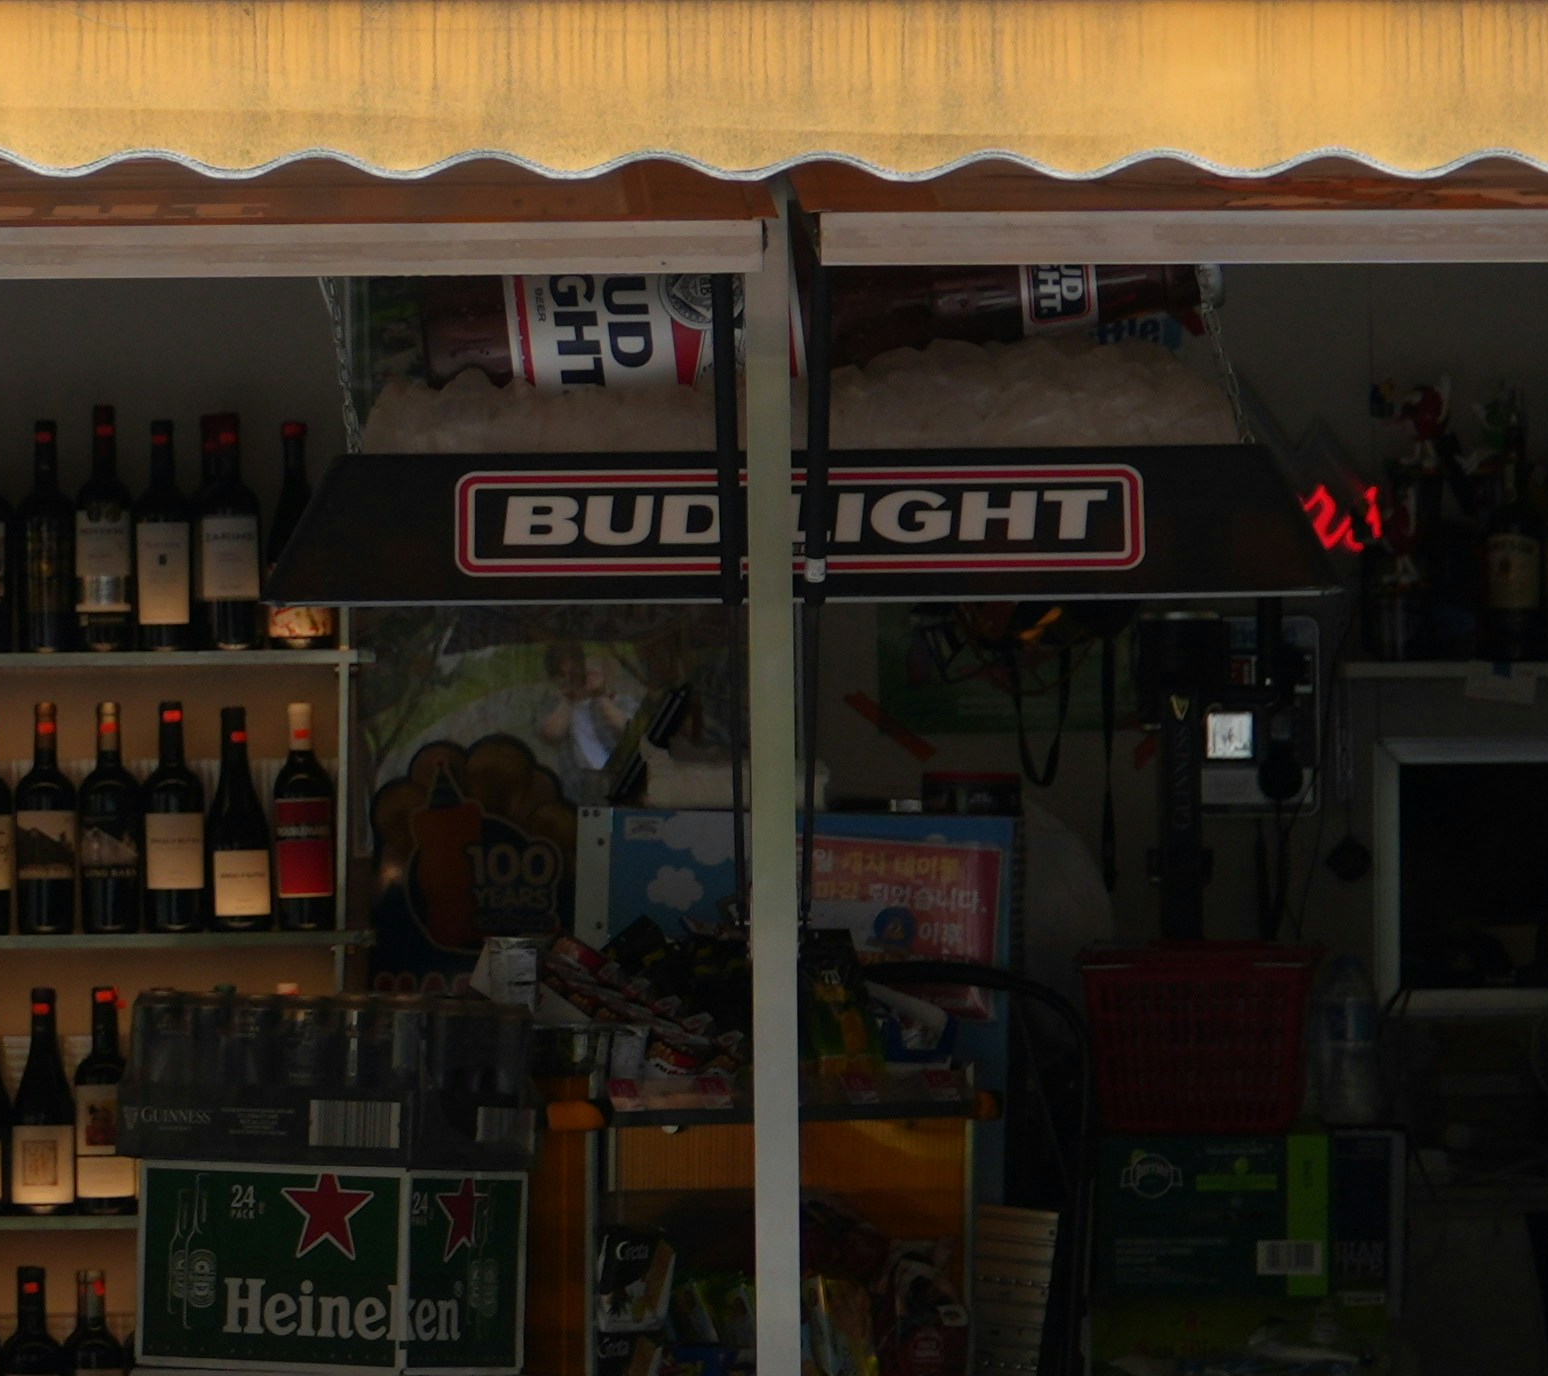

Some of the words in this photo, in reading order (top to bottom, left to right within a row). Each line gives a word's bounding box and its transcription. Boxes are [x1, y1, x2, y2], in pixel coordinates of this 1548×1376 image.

[550, 274, 605, 387] GHT
[603, 275, 654, 368] UD
[502, 494, 721, 547] BUD
[466, 842, 554, 886] 100
[473, 887, 551, 910] YEARS
[140, 1106, 212, 1125] GUINNESS
[231, 1184, 255, 1209] 24
[411, 1191, 430, 1216] 24
[223, 1278, 461, 1342] Heineken
